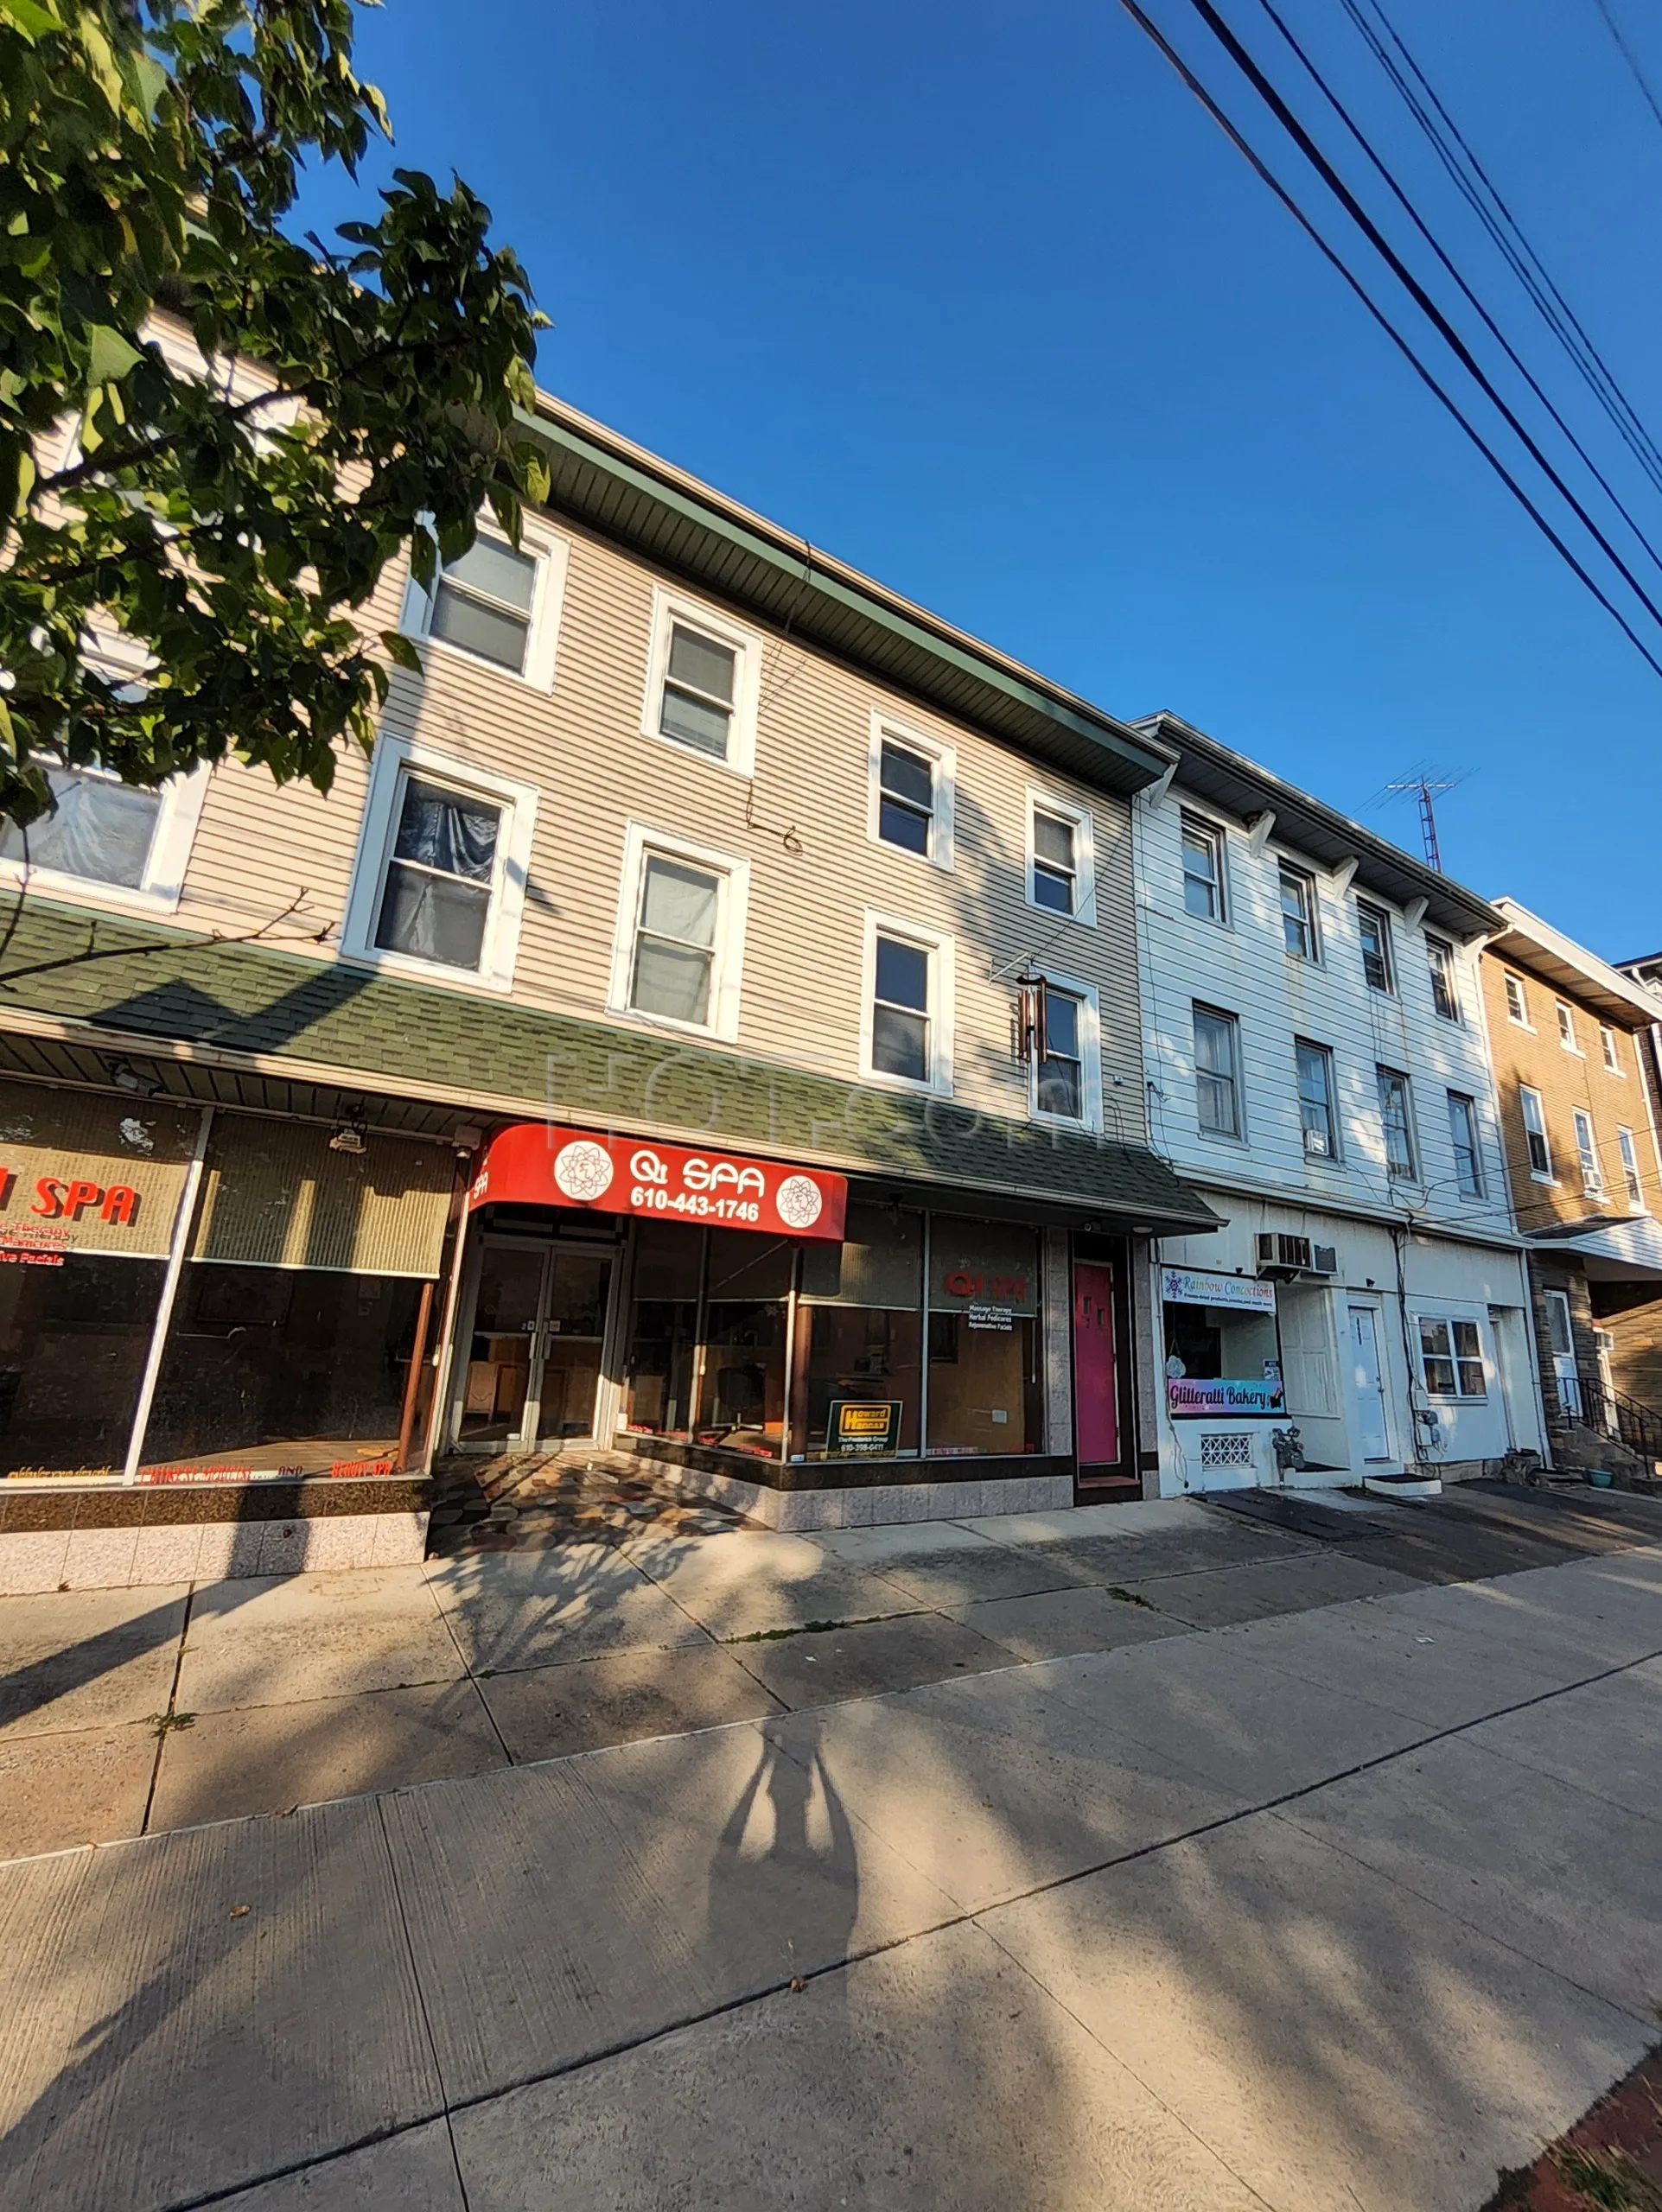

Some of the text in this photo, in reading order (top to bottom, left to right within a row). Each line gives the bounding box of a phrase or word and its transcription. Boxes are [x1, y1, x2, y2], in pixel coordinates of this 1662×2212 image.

[682, 1158, 765, 1198] SPA
[30, 1176, 136, 1223] SPA
[630, 1185, 760, 1223] 610-443-1746
[1182, 1275, 1273, 1298] Rainbow Concoctions
[992, 1306, 1012, 1314] Therapy
[1226, 1386, 1266, 1410] Bakery
[277, 1465, 303, 1477] AND
